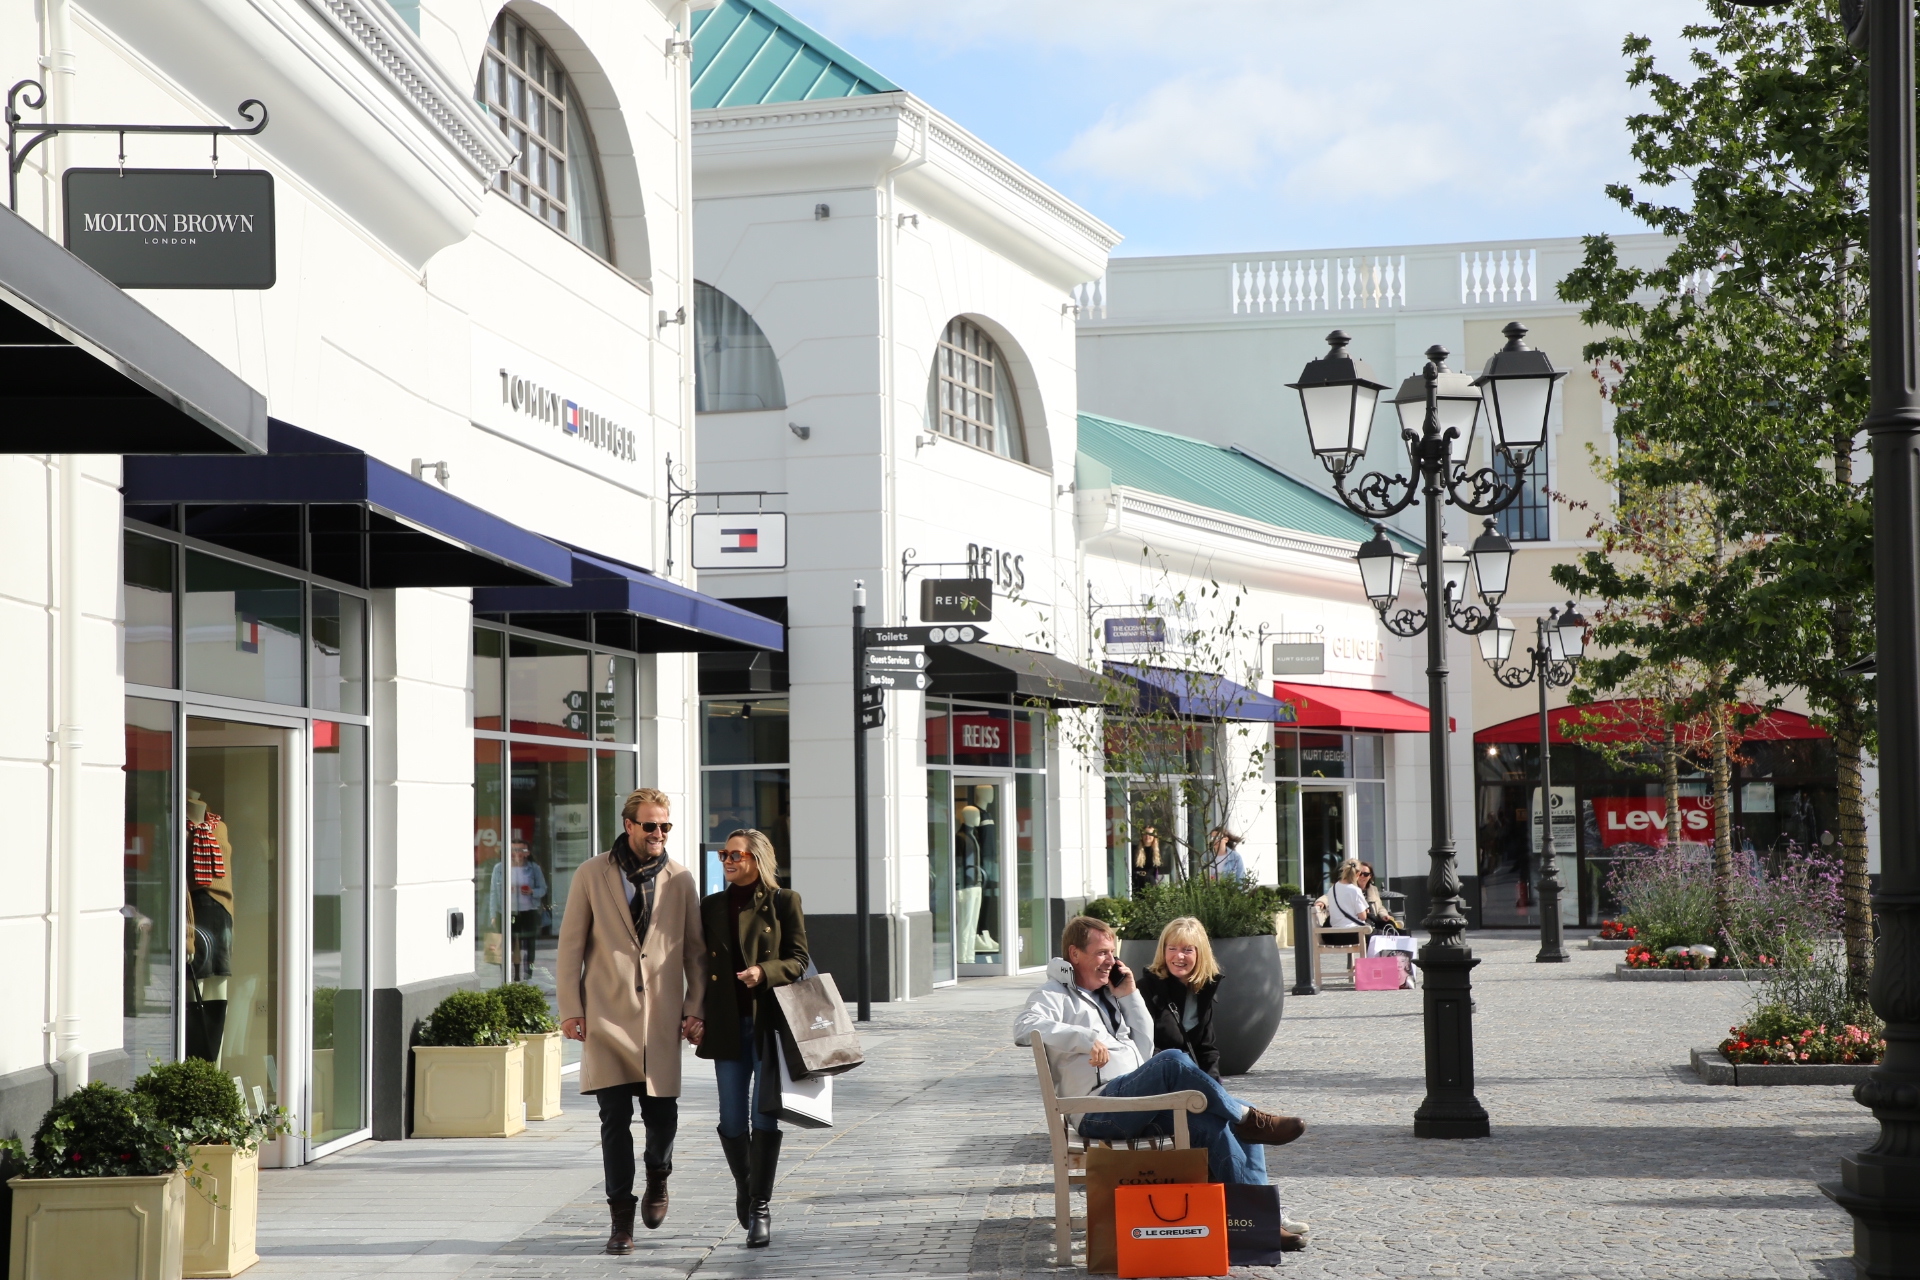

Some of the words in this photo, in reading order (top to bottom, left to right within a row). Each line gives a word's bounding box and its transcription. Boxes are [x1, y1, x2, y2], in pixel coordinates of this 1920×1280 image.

[84, 213, 168, 232] MOLTON
[173, 214, 254, 233] BROWN
[499, 368, 561, 429] TOMMY
[578, 406, 637, 464] HILFIGER
[967, 543, 1025, 591] REISS
[876, 632, 909, 642] Toilets
[870, 654, 887, 664] Guest
[887, 655, 910, 665] Services
[1332, 637, 1385, 662] GEIGER
[870, 674, 881, 685] Bus
[881, 675, 895, 687] Stop
[962, 724, 1000, 749] REISS
[1303, 749, 1322, 761] KURT
[1323, 750, 1350, 762] GEIGER
[1607, 808, 1709, 831] Lev's
[1159, 1228, 1203, 1236] CREUSET
